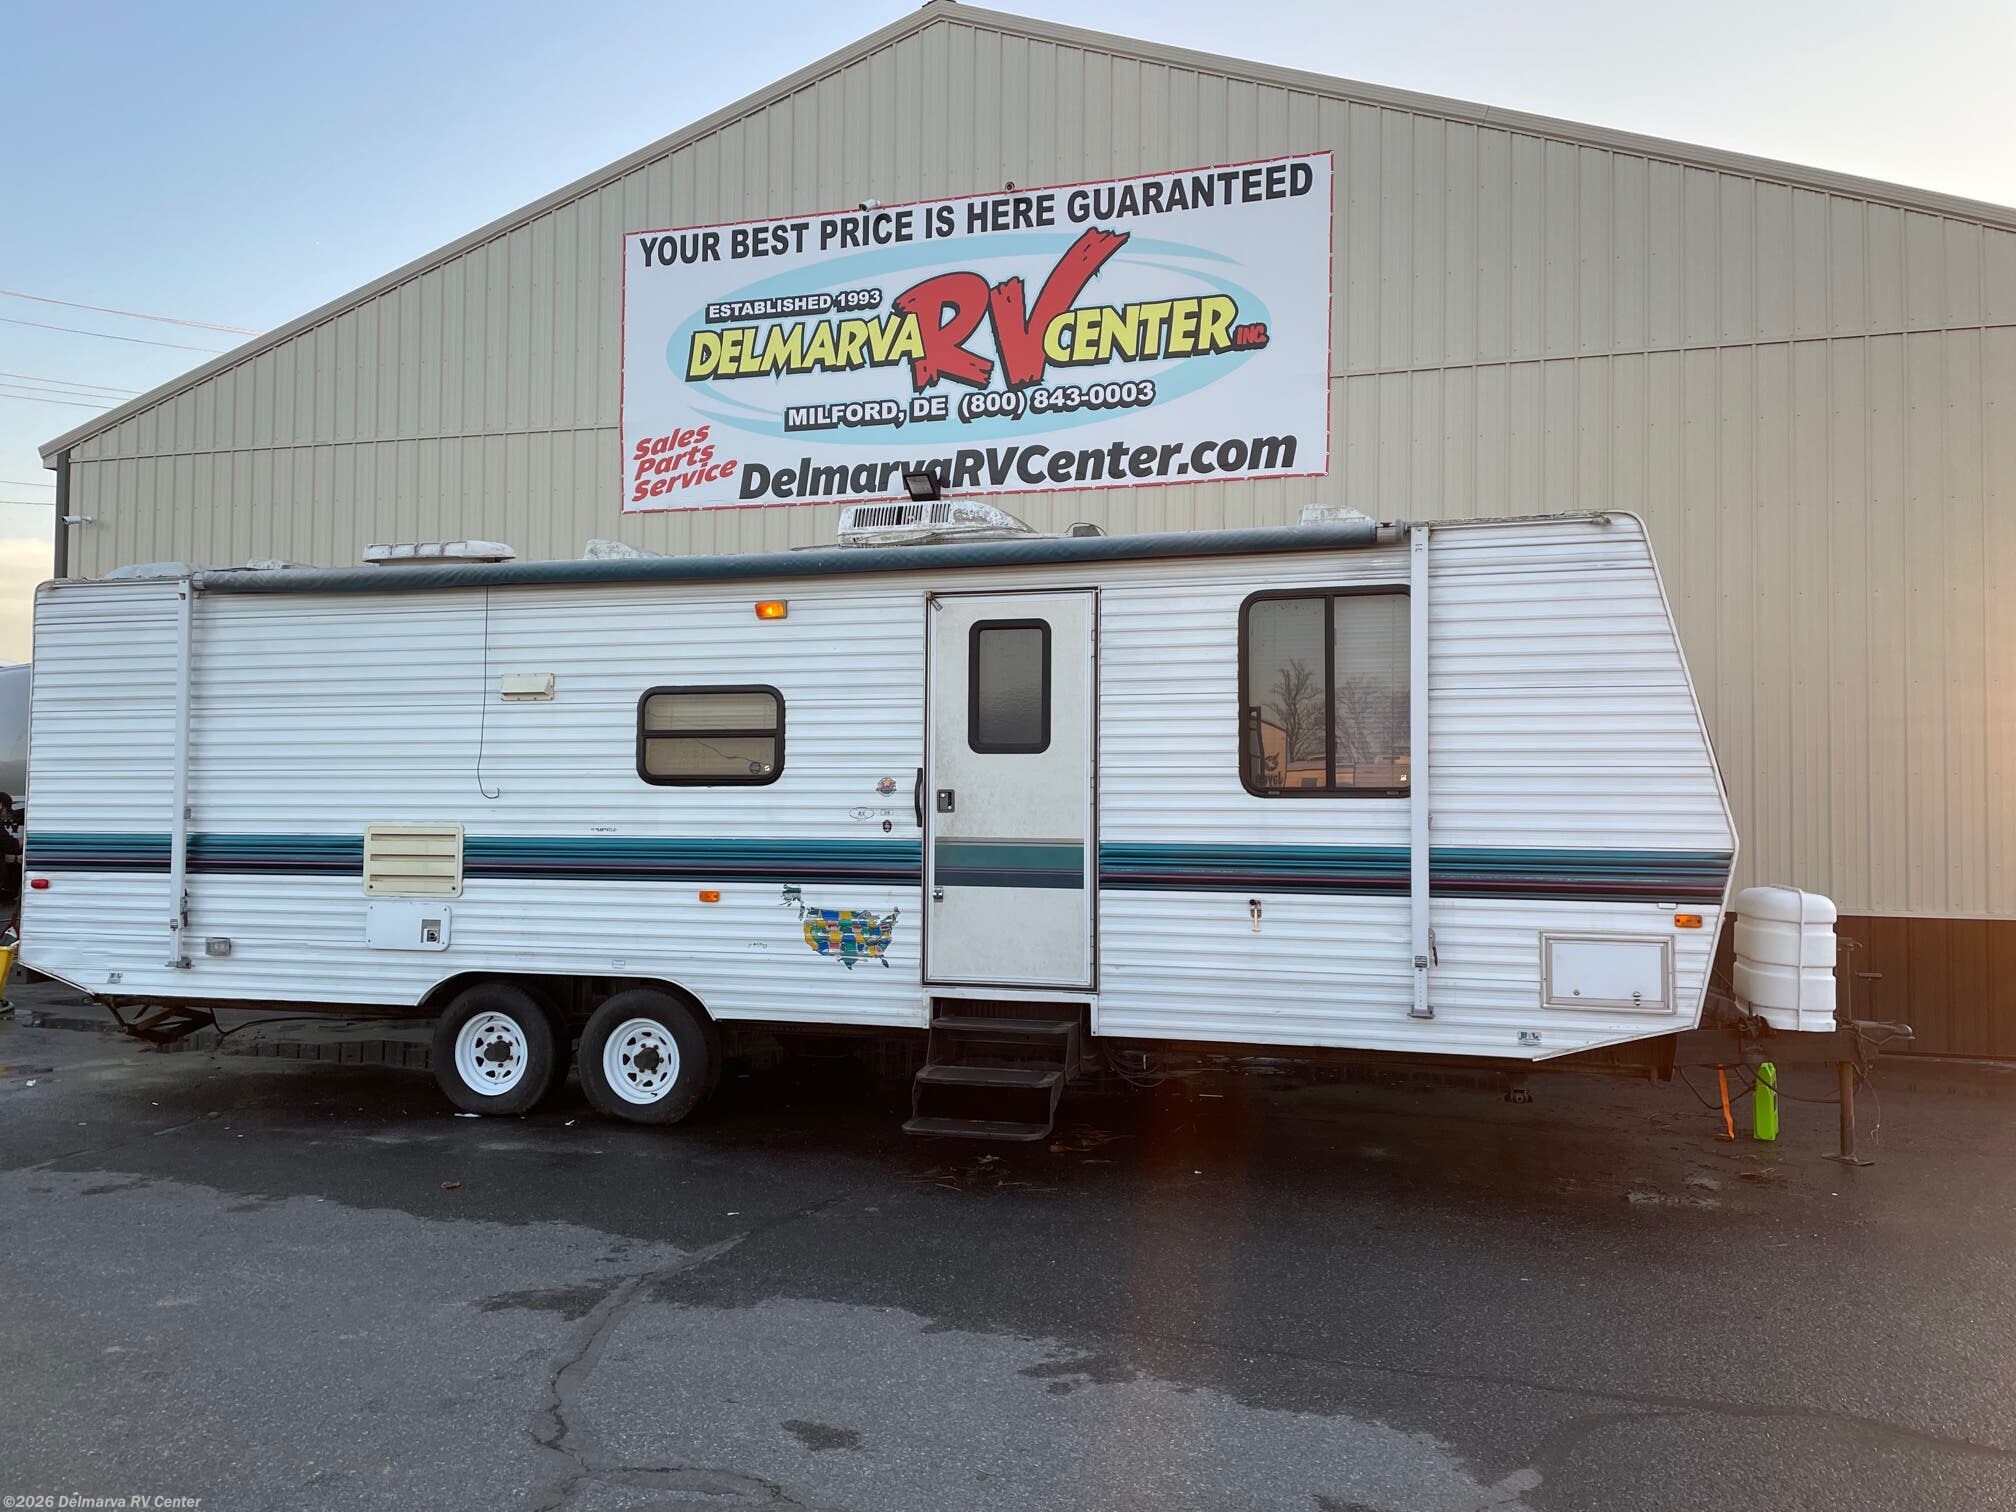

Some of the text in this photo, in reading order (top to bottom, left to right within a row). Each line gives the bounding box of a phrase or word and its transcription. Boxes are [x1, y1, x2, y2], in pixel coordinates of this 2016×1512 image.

[640, 162, 1313, 267] YOUR BEST PRICE IS HERE GUARANTEED
[686, 314, 926, 381] DELMARVA
[892, 227, 1131, 394] RV
[1044, 294, 1238, 367] CENTER
[709, 290, 881, 319] ESTABLISHED 1993
[788, 382, 1154, 427] MILFORD, DE (800) 843-0003
[633, 425, 710, 460] Sales
[635, 443, 715, 481] Parts
[632, 459, 738, 502] Service
